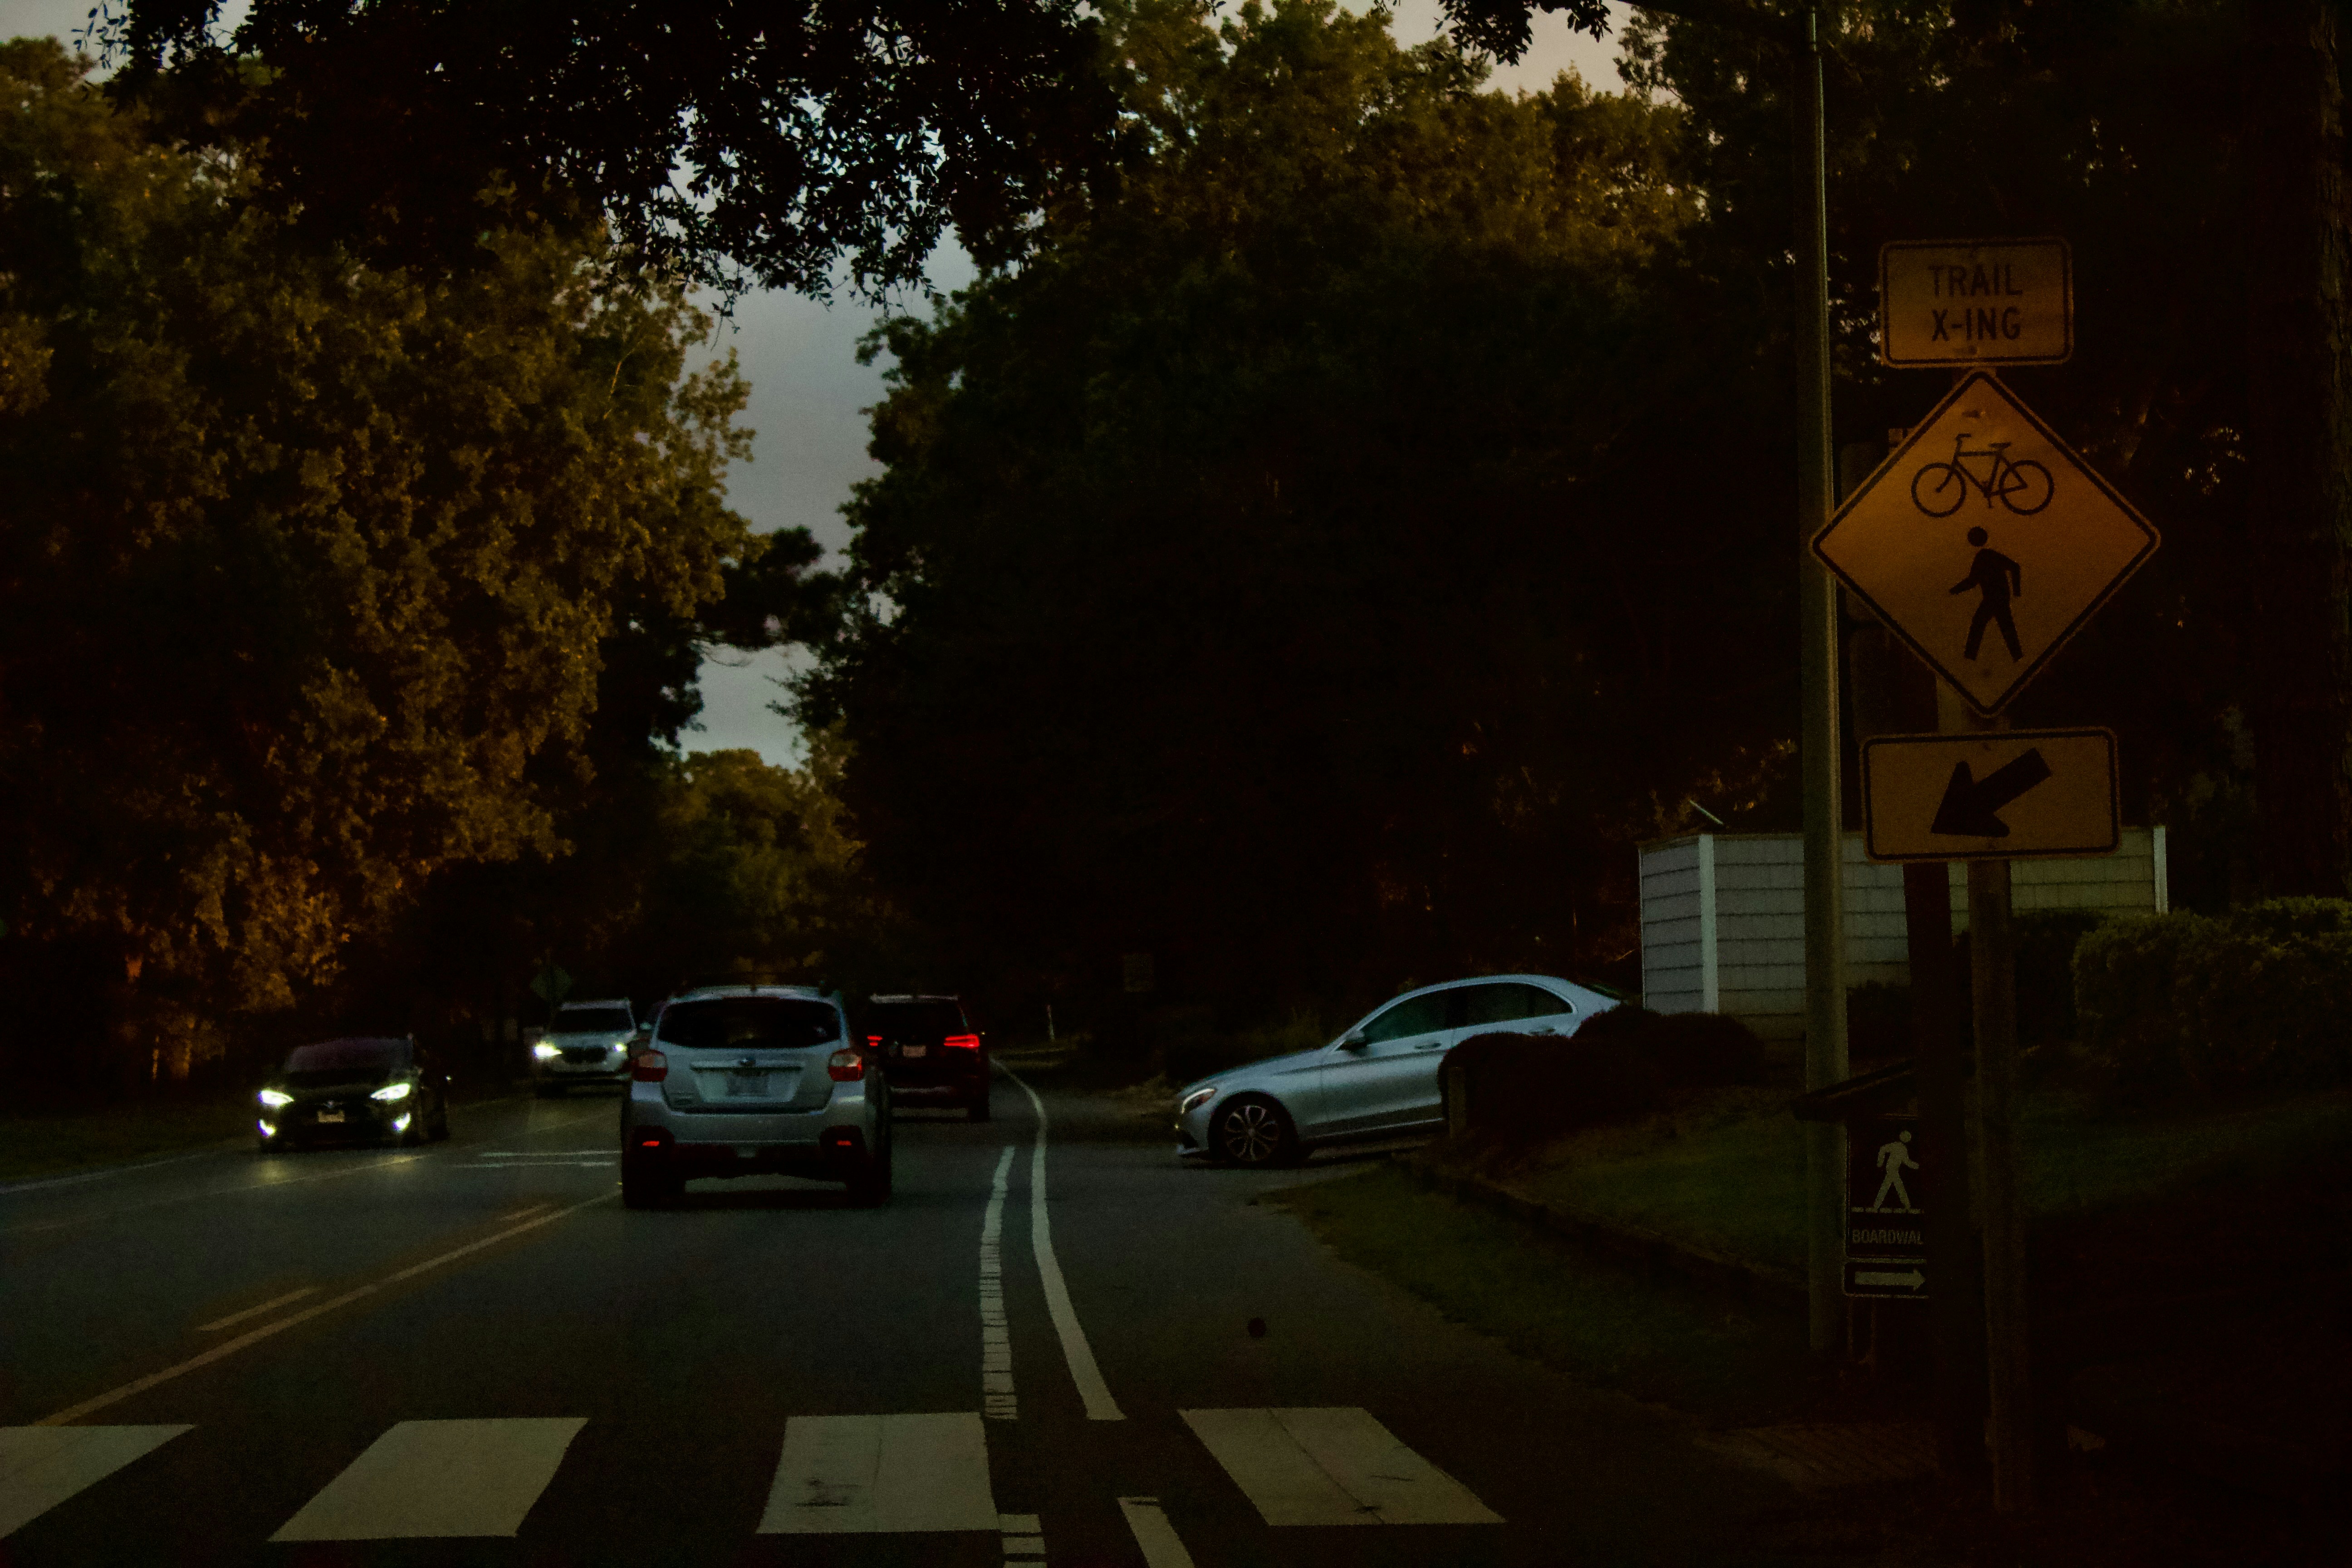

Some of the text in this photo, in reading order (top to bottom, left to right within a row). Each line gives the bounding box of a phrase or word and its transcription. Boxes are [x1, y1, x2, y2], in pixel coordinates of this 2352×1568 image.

[1928, 264, 2023, 296] TRAIL
[1932, 307, 2020, 341] X-ING
[1852, 1229, 1923, 1244] BOARDWAL
